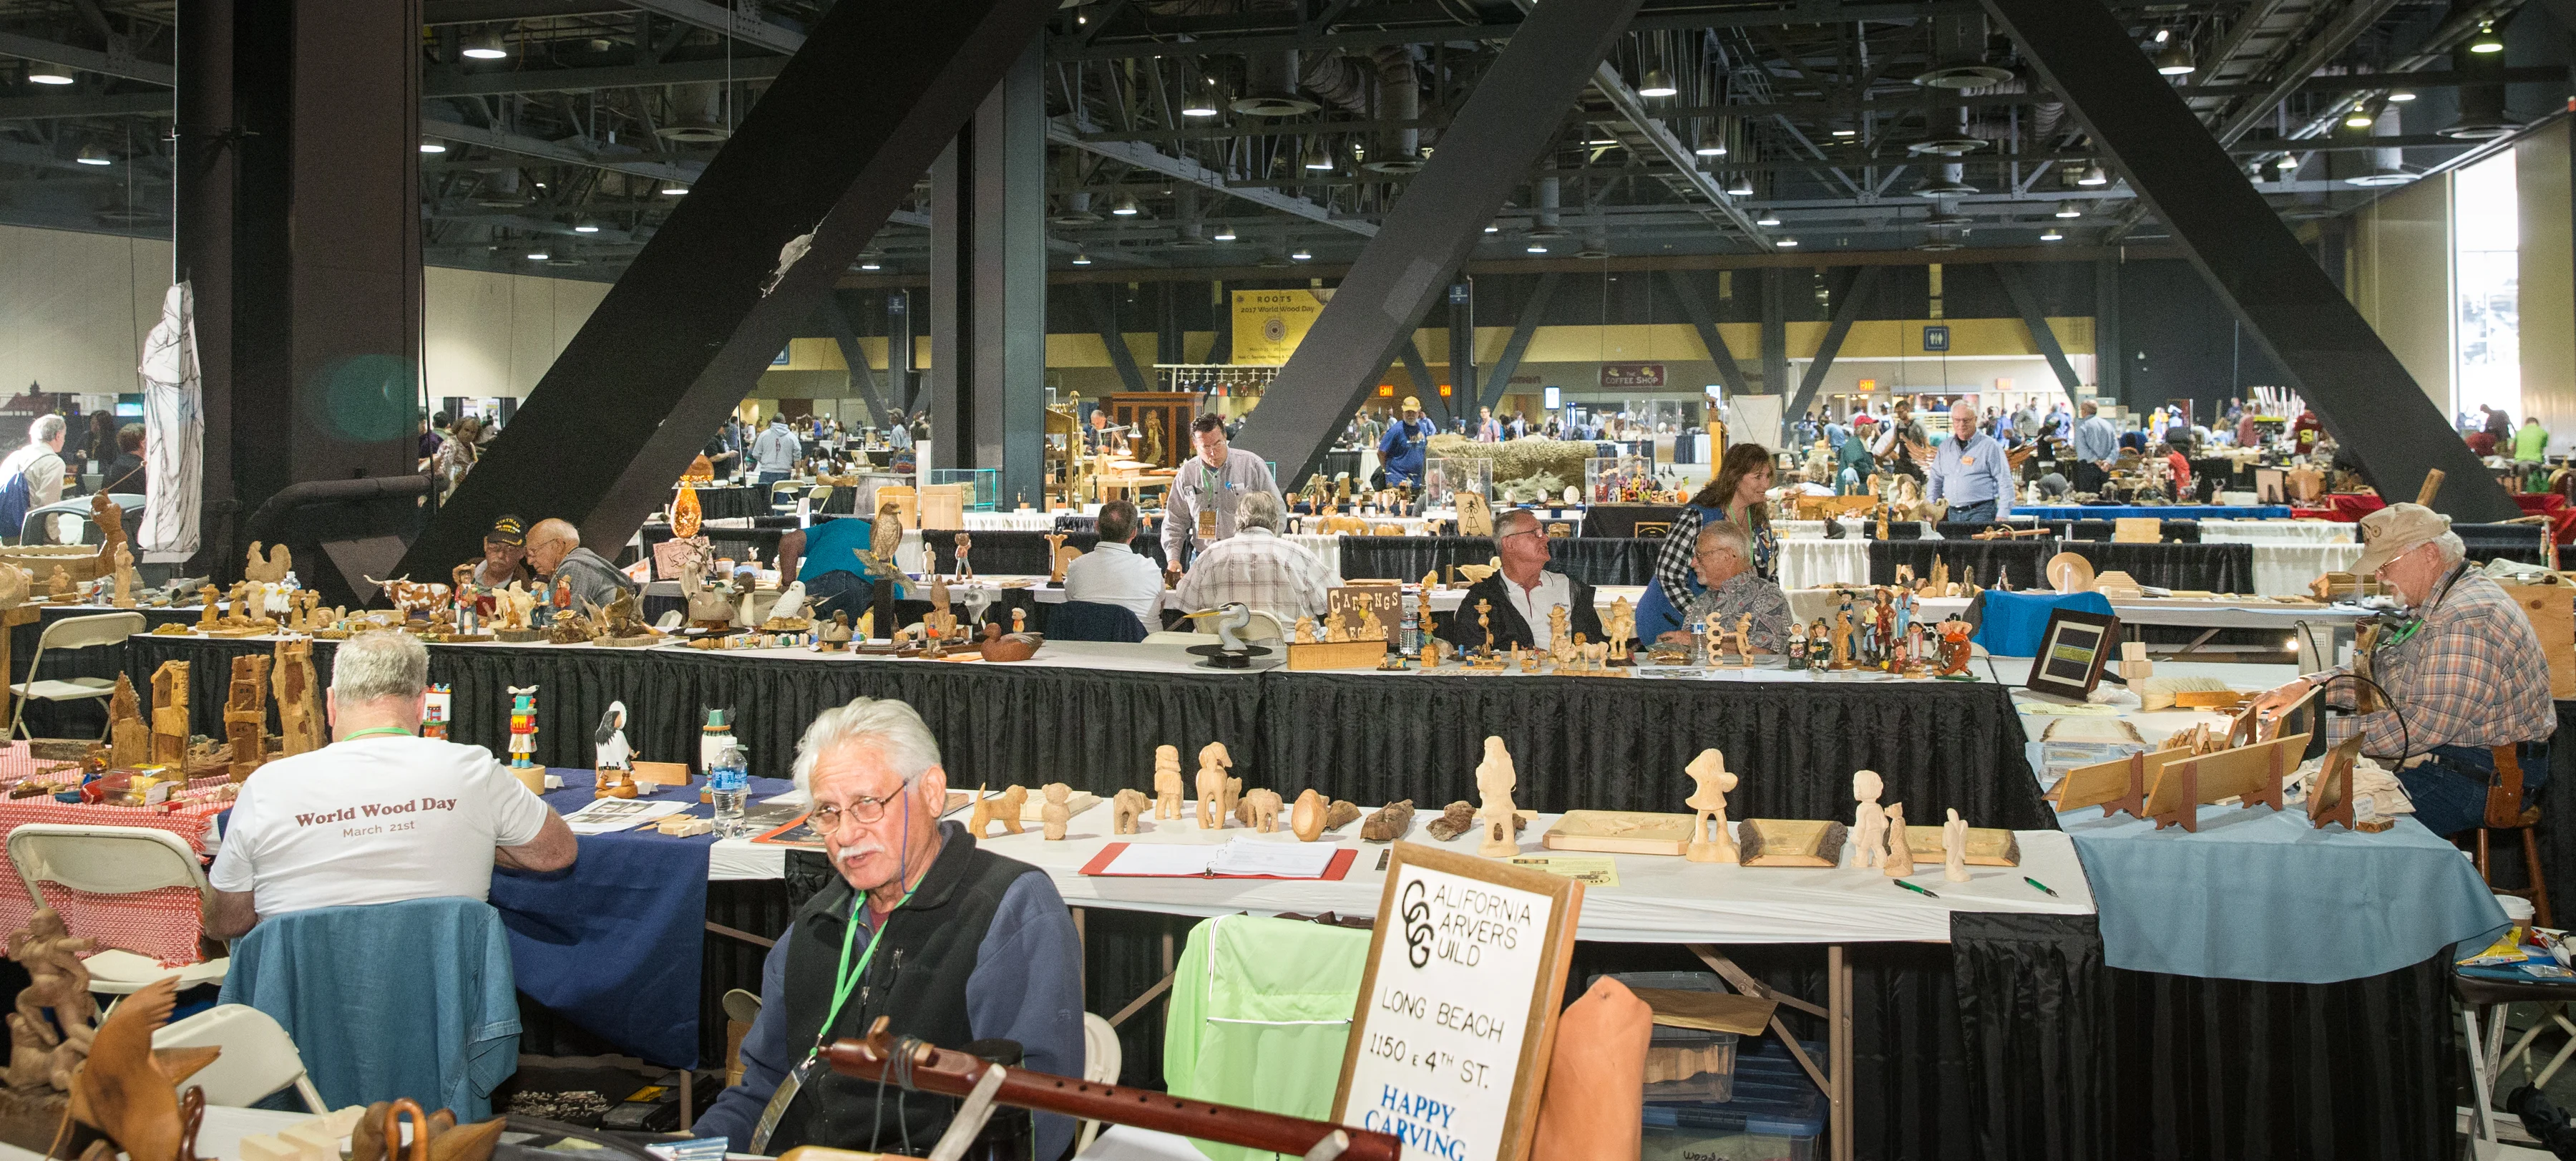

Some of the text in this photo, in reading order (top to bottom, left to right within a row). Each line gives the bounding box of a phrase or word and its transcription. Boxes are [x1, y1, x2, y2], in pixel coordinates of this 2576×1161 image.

[496, 518, 521, 528] VIETNAM
[1330, 589, 1398, 614] CARINGS
[295, 797, 457, 827] World Wood Day
[343, 820, 415, 837] March 21st
[1382, 986, 1505, 1043] LONG BEACH
[1370, 1032, 1489, 1089] 1150 E 4TH ST.
[1380, 1083, 1456, 1129] HAPPY
[1365, 1109, 1466, 1161] CARVING
